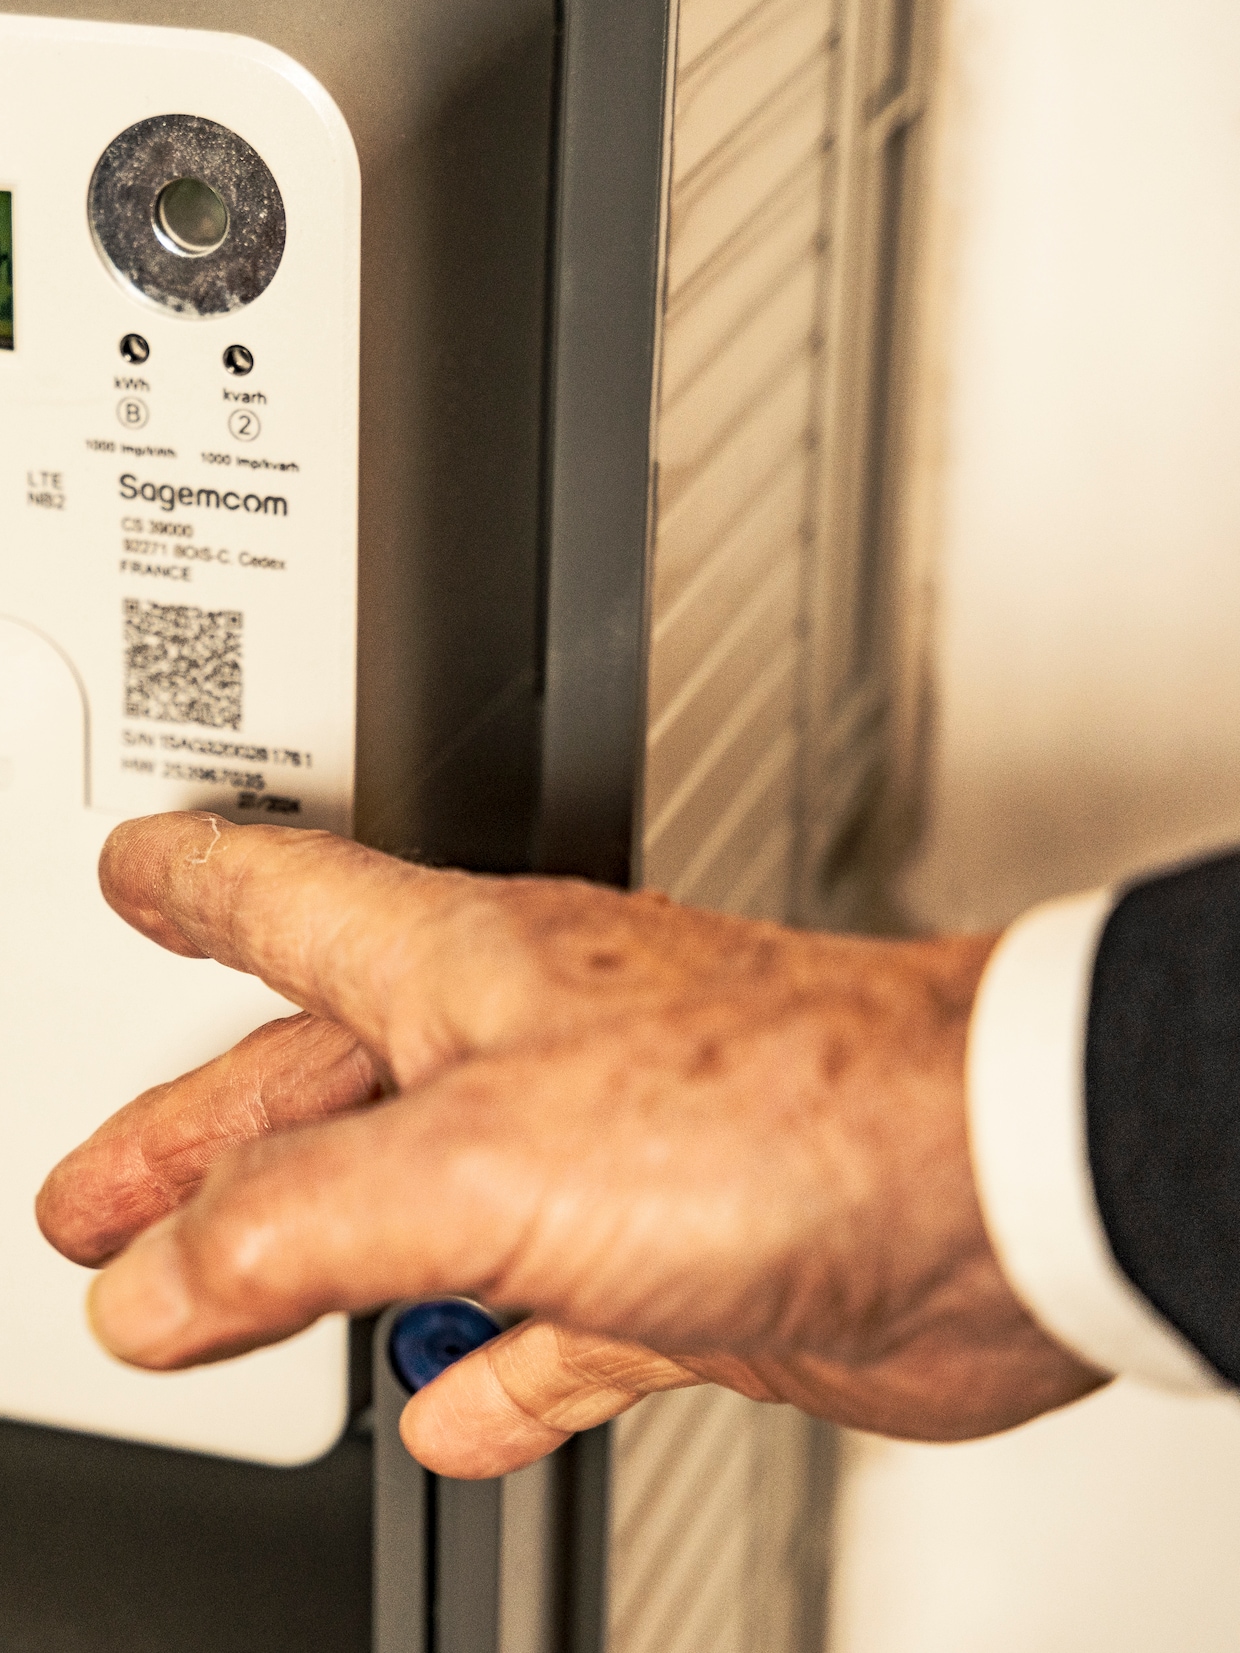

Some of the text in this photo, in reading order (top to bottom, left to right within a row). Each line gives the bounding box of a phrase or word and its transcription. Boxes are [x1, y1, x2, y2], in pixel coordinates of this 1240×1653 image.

[114, 377, 150, 392] kWh
[223, 388, 267, 405] kvarh
[126, 403, 141, 424] B
[238, 415, 251, 435] 2
[201, 452, 231, 466] 1000
[27, 471, 63, 490] LTE
[119, 473, 289, 518] Sagemcom
[119, 560, 191, 582] FRANCE
